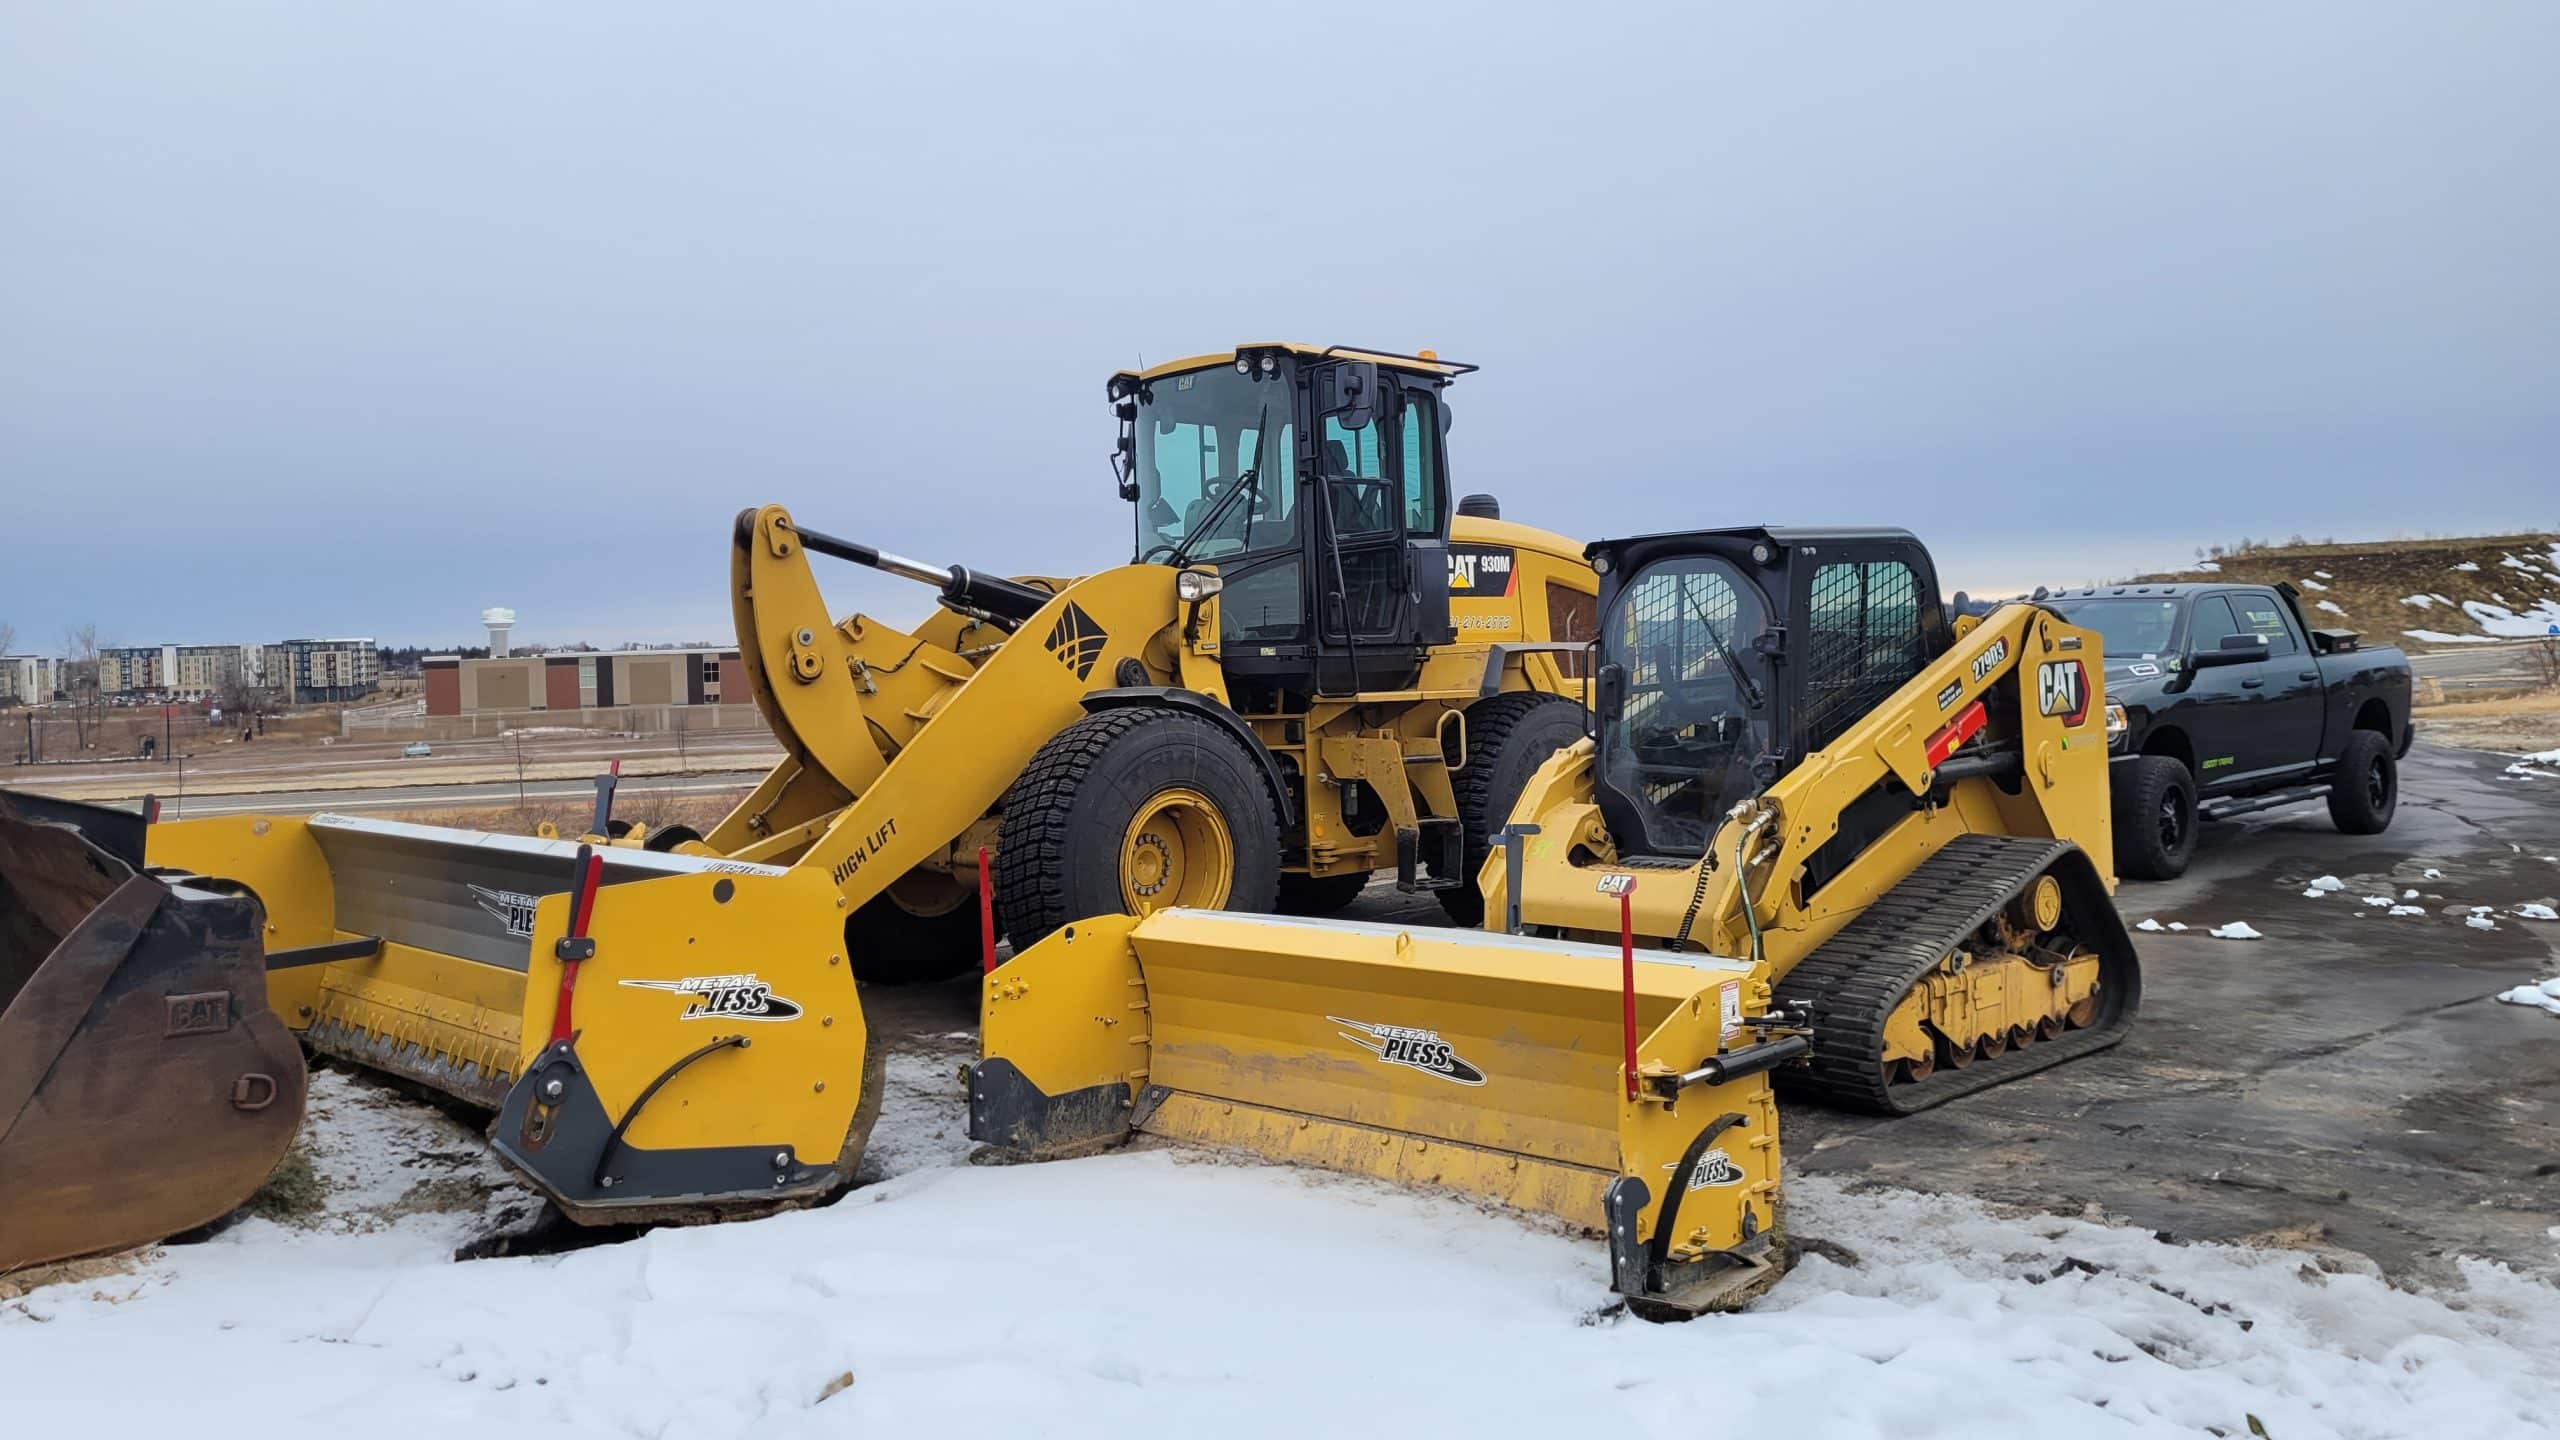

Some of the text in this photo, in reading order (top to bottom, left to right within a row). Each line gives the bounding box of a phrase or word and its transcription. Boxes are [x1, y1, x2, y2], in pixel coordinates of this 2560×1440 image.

[1481, 555, 1510, 573] 930M
[1972, 640, 2005, 681] 279D3
[2038, 661, 2078, 716] CAT
[832, 818, 896, 887] HIGH LIFT
[1597, 875, 1633, 893] CAT
[510, 907, 536, 933] PLE
[681, 976, 758, 990] METAL
[170, 999, 227, 1027] CAT
[1374, 1025, 1439, 1043] METAL
[1383, 1038, 1450, 1068] PLESS
[1694, 1158, 1729, 1186] PLESS
